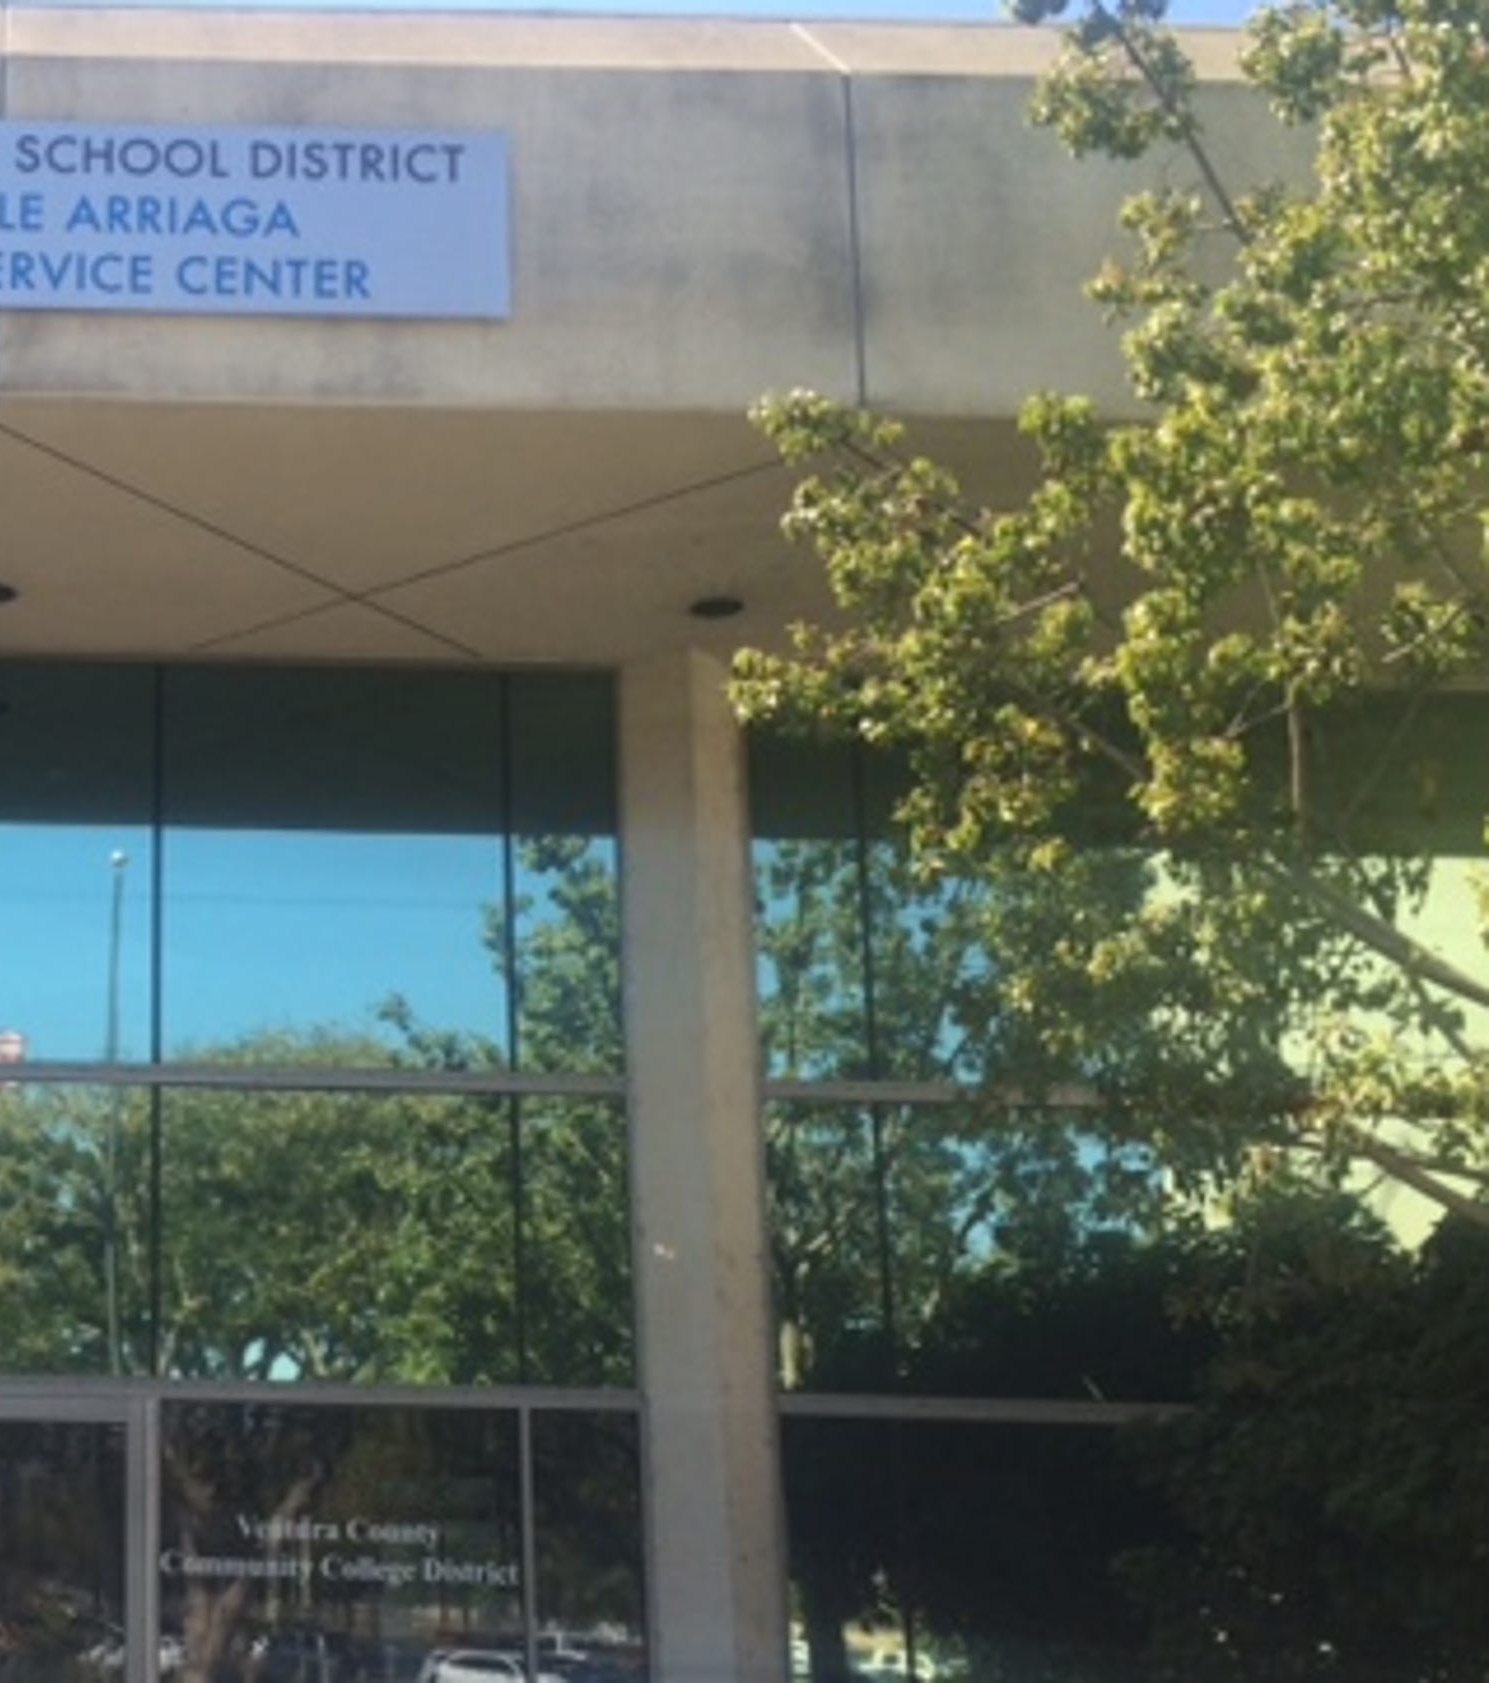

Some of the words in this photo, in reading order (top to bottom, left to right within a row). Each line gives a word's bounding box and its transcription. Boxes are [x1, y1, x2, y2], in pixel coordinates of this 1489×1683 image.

[15, 135, 230, 179] SCHOOL
[249, 142, 466, 183] DISTRICT
[66, 194, 300, 238] ARRIAGA
[177, 256, 371, 298] CENTER
[237, 1512, 340, 1540] Ventura
[346, 1517, 440, 1548] County
[160, 1551, 312, 1583] Community
[320, 1556, 417, 1586] College
[423, 1557, 520, 1586] District
